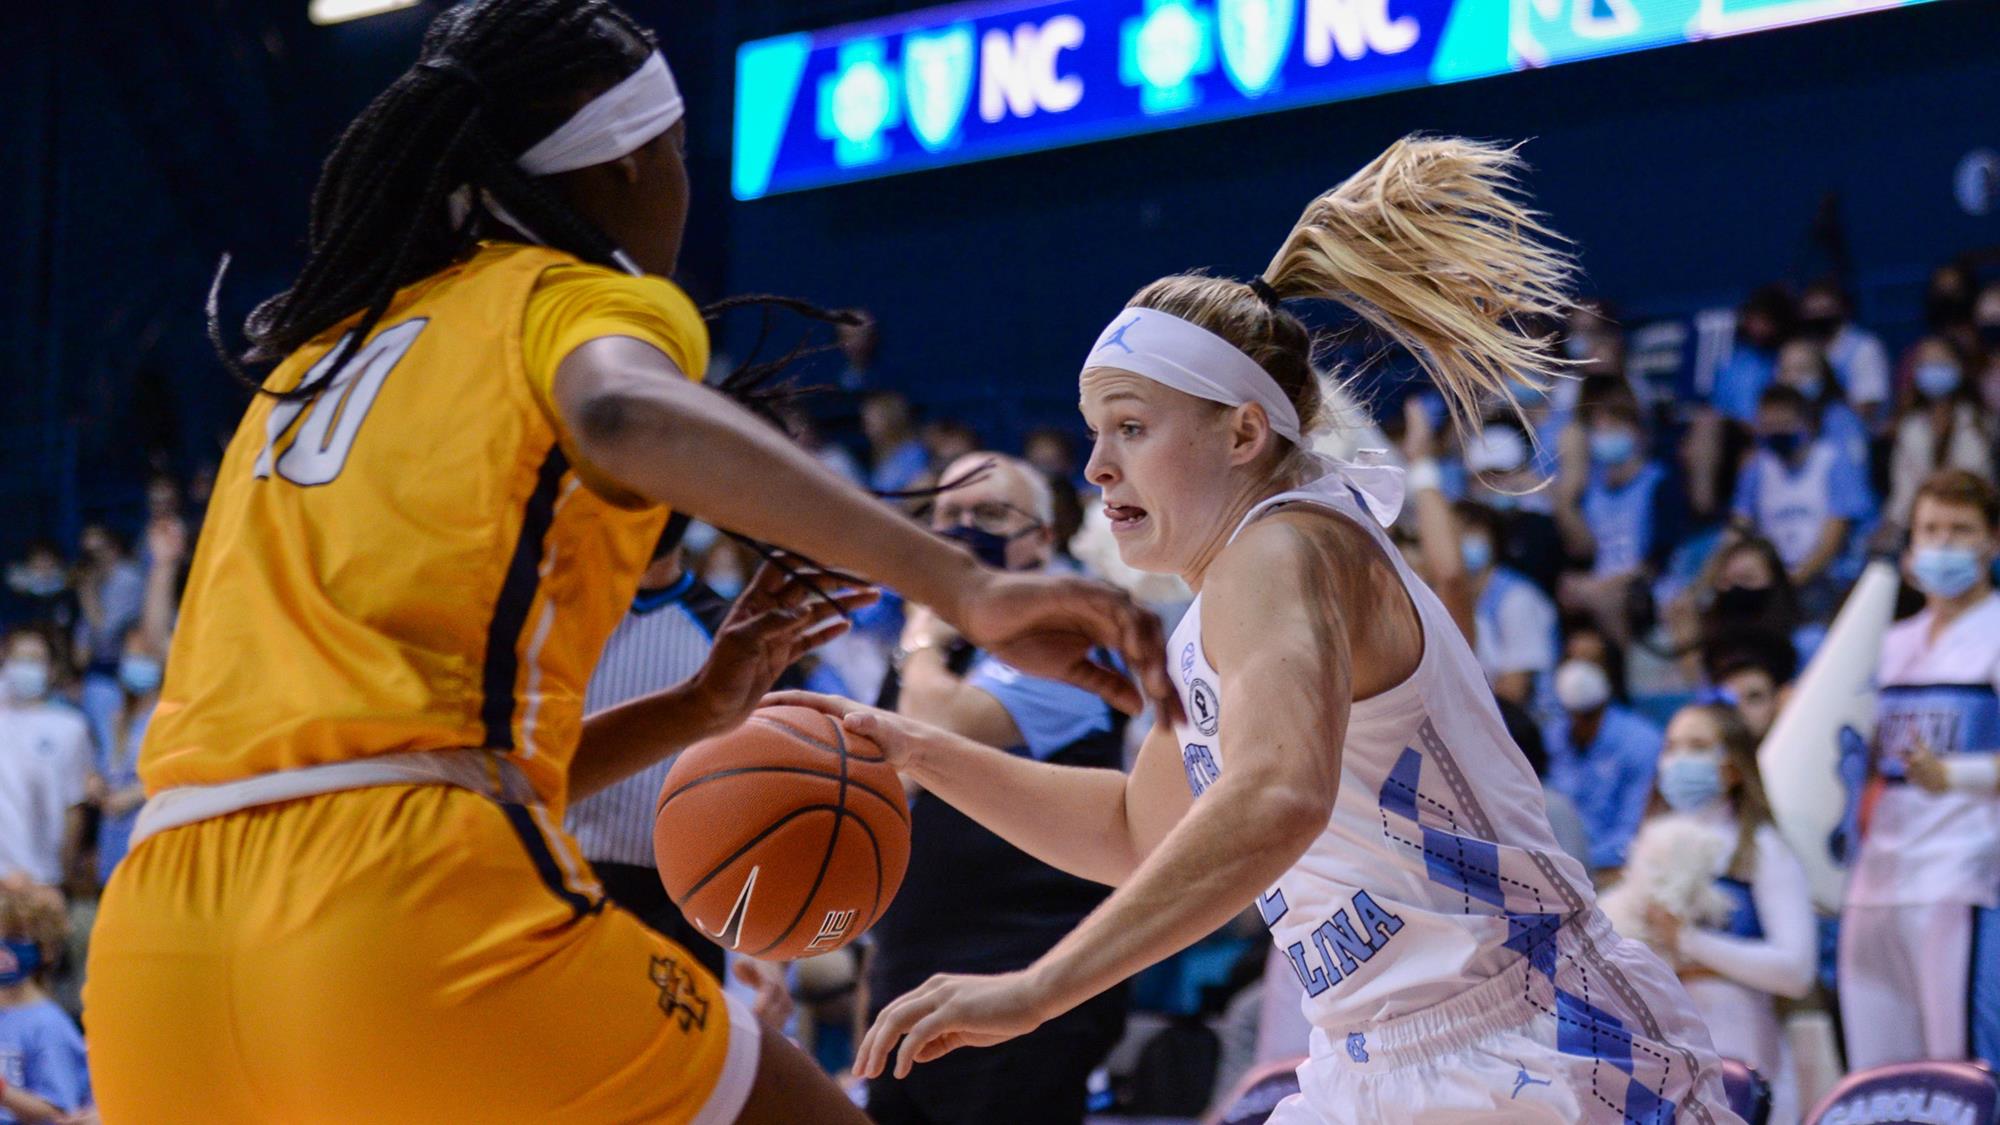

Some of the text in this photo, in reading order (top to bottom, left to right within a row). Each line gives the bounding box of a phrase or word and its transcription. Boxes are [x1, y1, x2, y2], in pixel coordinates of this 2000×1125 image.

[980, 14, 1084, 122] NC
[1303, 0, 1420, 66] NC
[253, 316, 430, 487] 10
[1283, 888, 1406, 999] LINA
